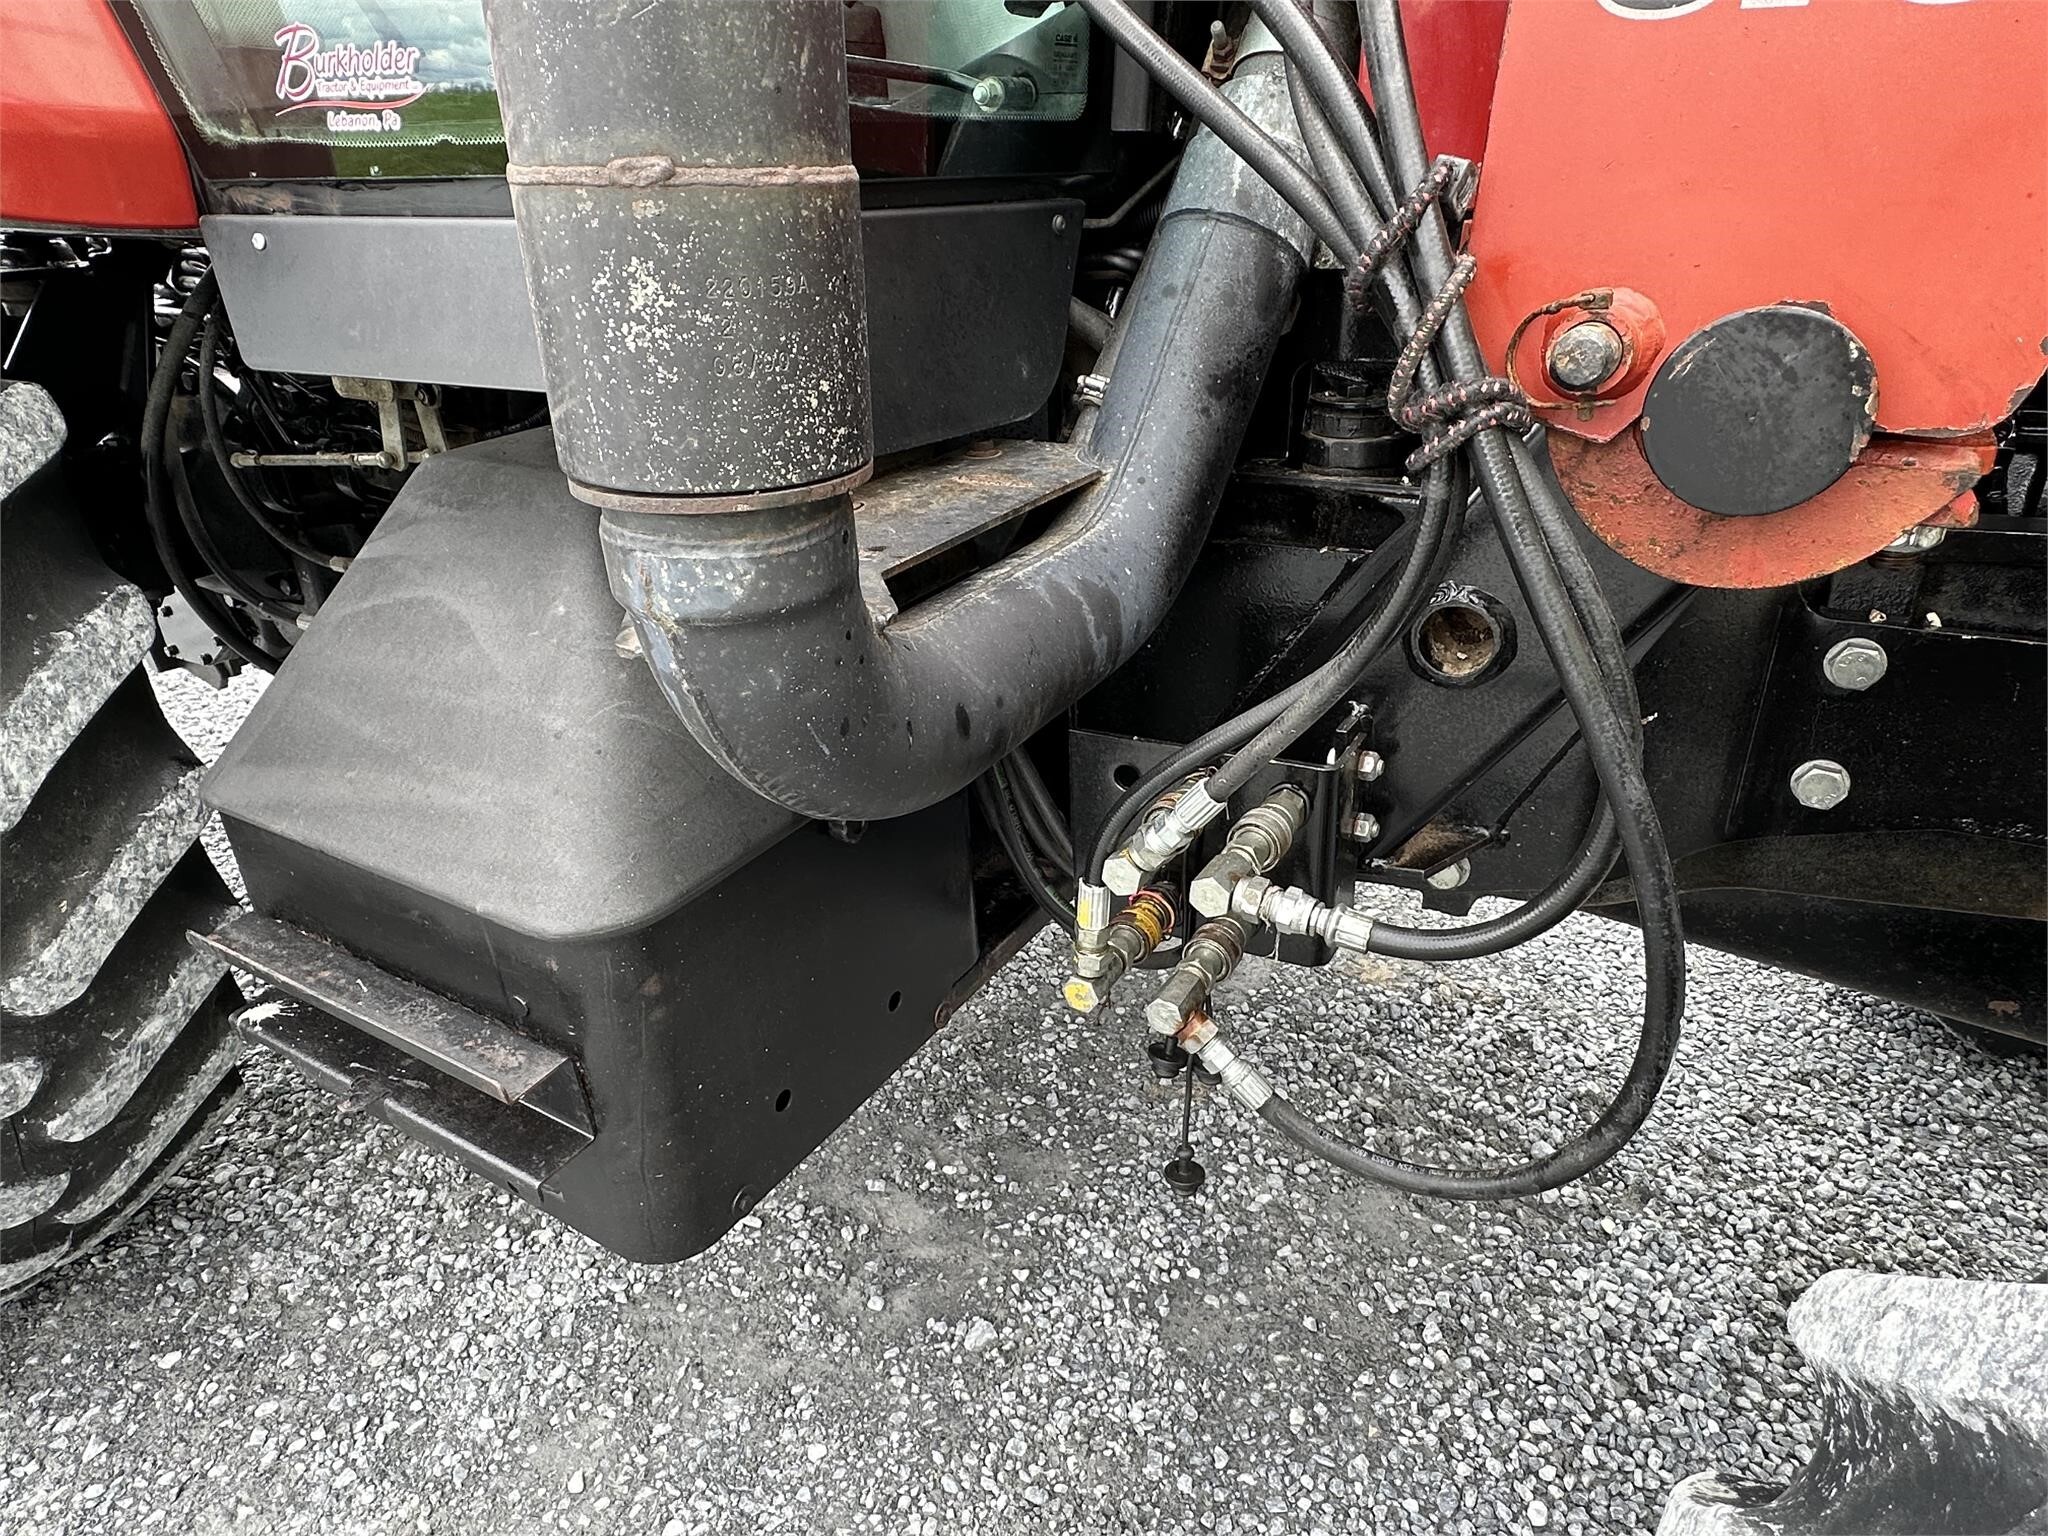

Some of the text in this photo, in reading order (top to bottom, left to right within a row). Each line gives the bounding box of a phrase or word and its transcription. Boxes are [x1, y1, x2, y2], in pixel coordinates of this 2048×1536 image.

[274, 22, 420, 100] Burkholder
[316, 79, 348, 95] Tractor
[360, 77, 410, 97] Equipment
[382, 110, 400, 130] Pa
